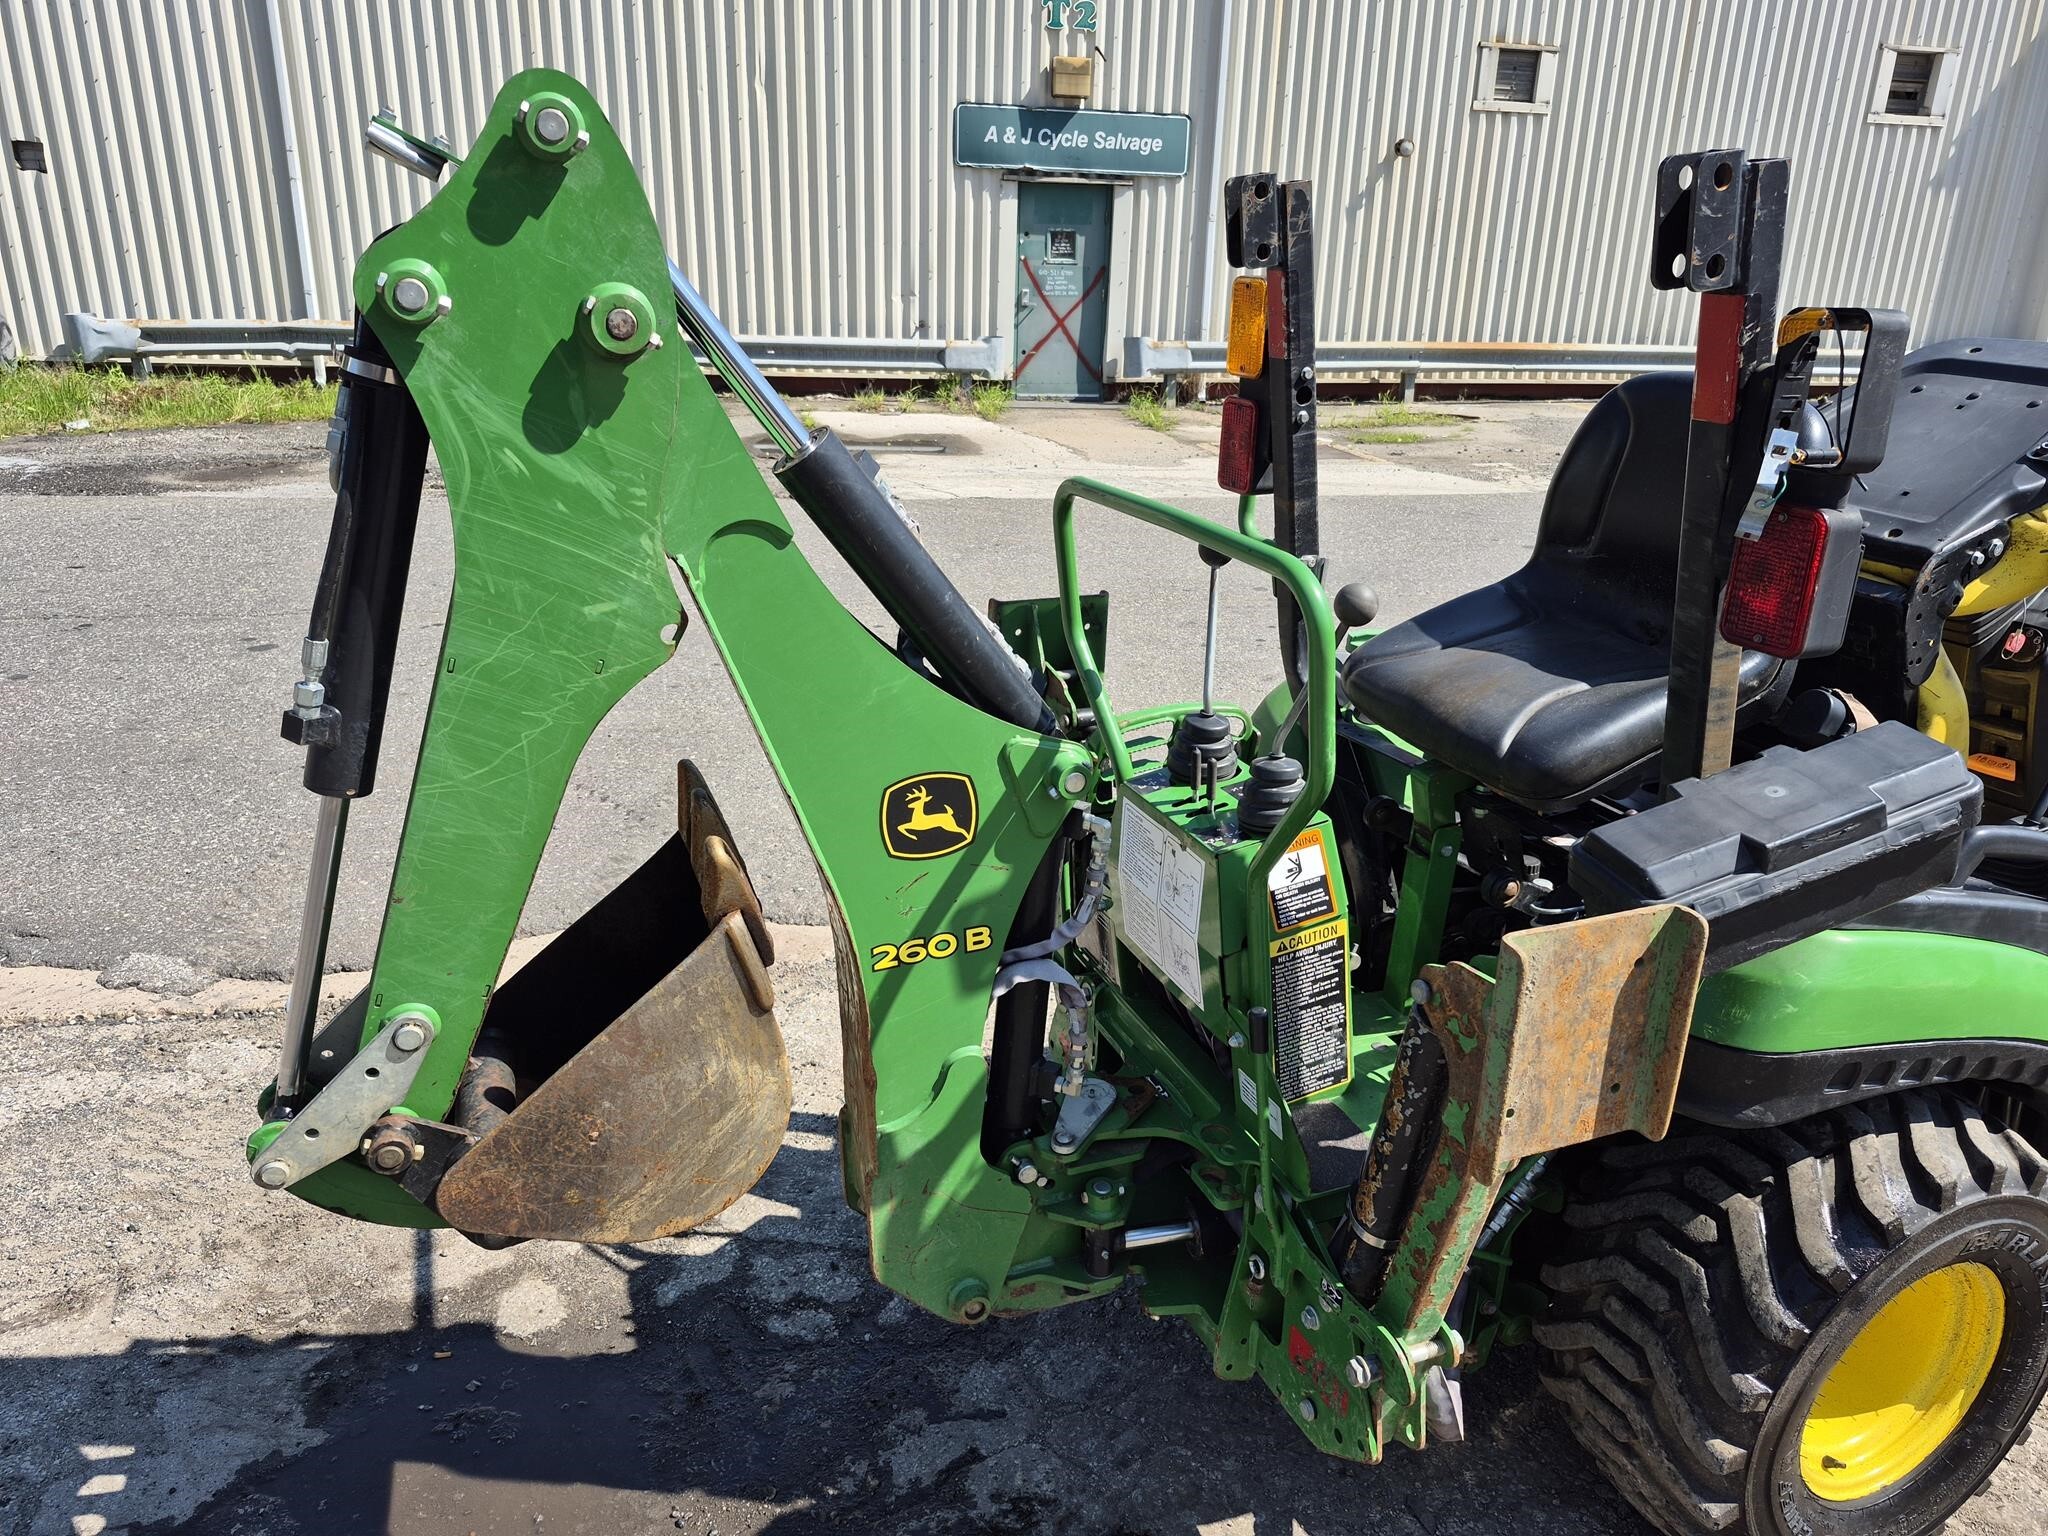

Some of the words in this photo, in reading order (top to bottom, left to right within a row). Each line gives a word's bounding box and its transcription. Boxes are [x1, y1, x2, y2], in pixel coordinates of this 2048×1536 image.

[983, 125, 998, 143] A
[1003, 126, 1017, 144] &
[1021, 128, 1033, 145] J
[1037, 128, 1089, 151] Cycle
[1093, 131, 1164, 156] Salvage
[871, 932, 959, 973] 260
[964, 925, 993, 954] B
[1278, 952, 1295, 963] HELP
[1295, 946, 1314, 958] AVOID
[1314, 939, 1338, 951] INJURY
[1288, 924, 1338, 950] CAUTION
